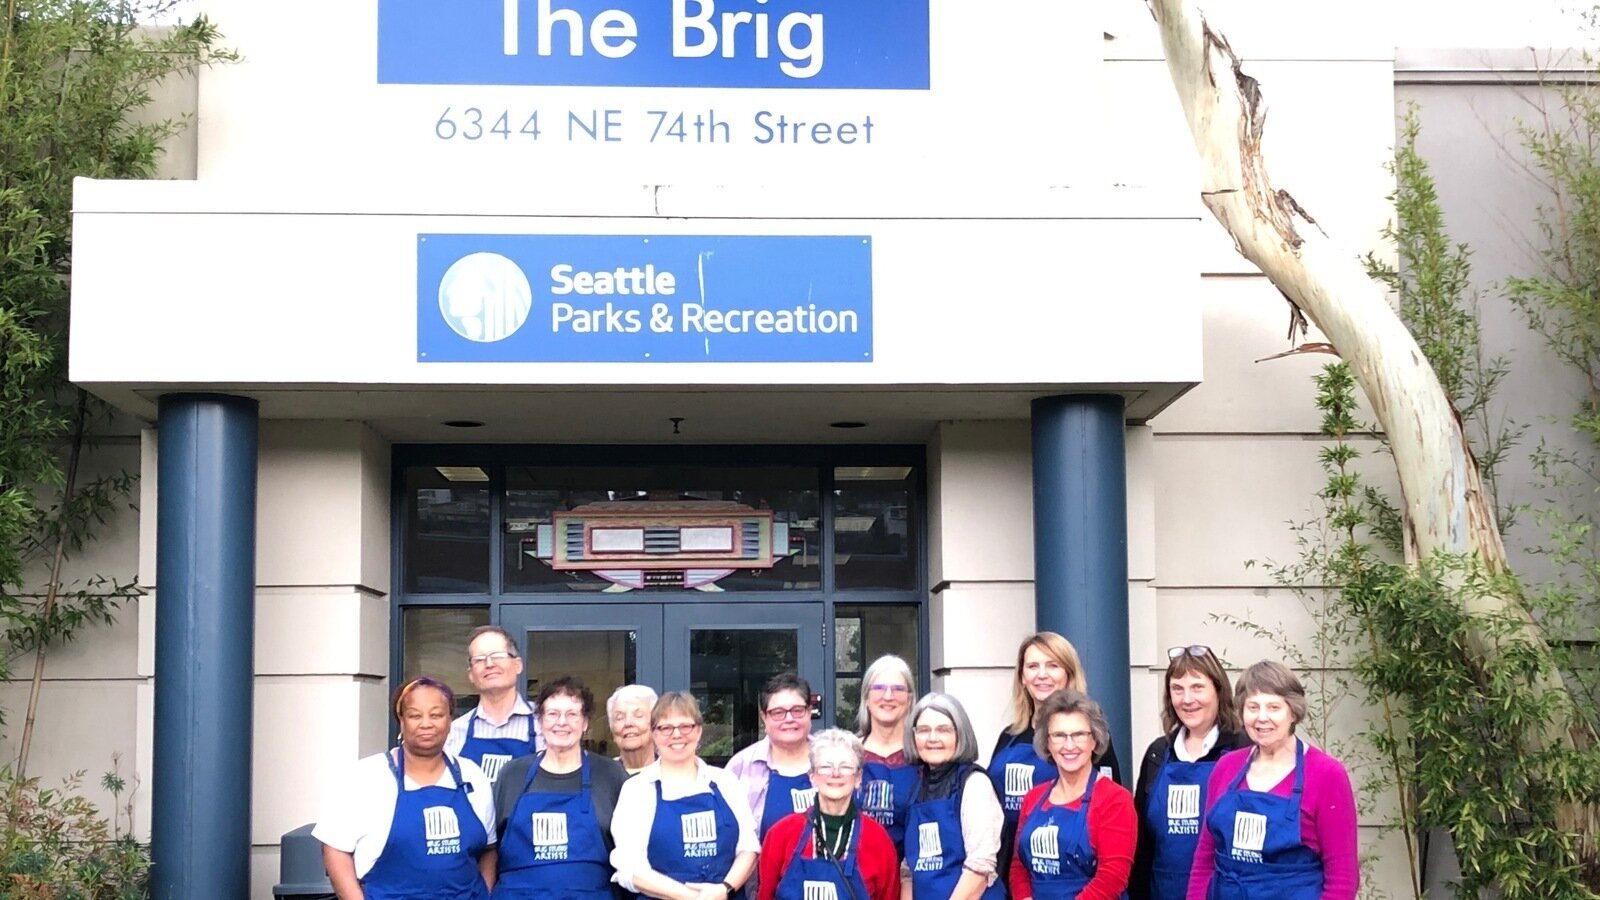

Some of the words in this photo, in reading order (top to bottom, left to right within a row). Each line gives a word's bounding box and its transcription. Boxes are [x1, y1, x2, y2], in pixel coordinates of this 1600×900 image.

[672, 0, 824, 78] Brig
[434, 106, 543, 141] 6344
[567, 109, 622, 142] NE
[646, 109, 730, 144] 74th
[754, 110, 875, 145] Street
[550, 263, 676, 295] Seattle
[551, 302, 642, 333] Parks
[649, 302, 675, 333] &
[681, 302, 859, 334] Recreation
